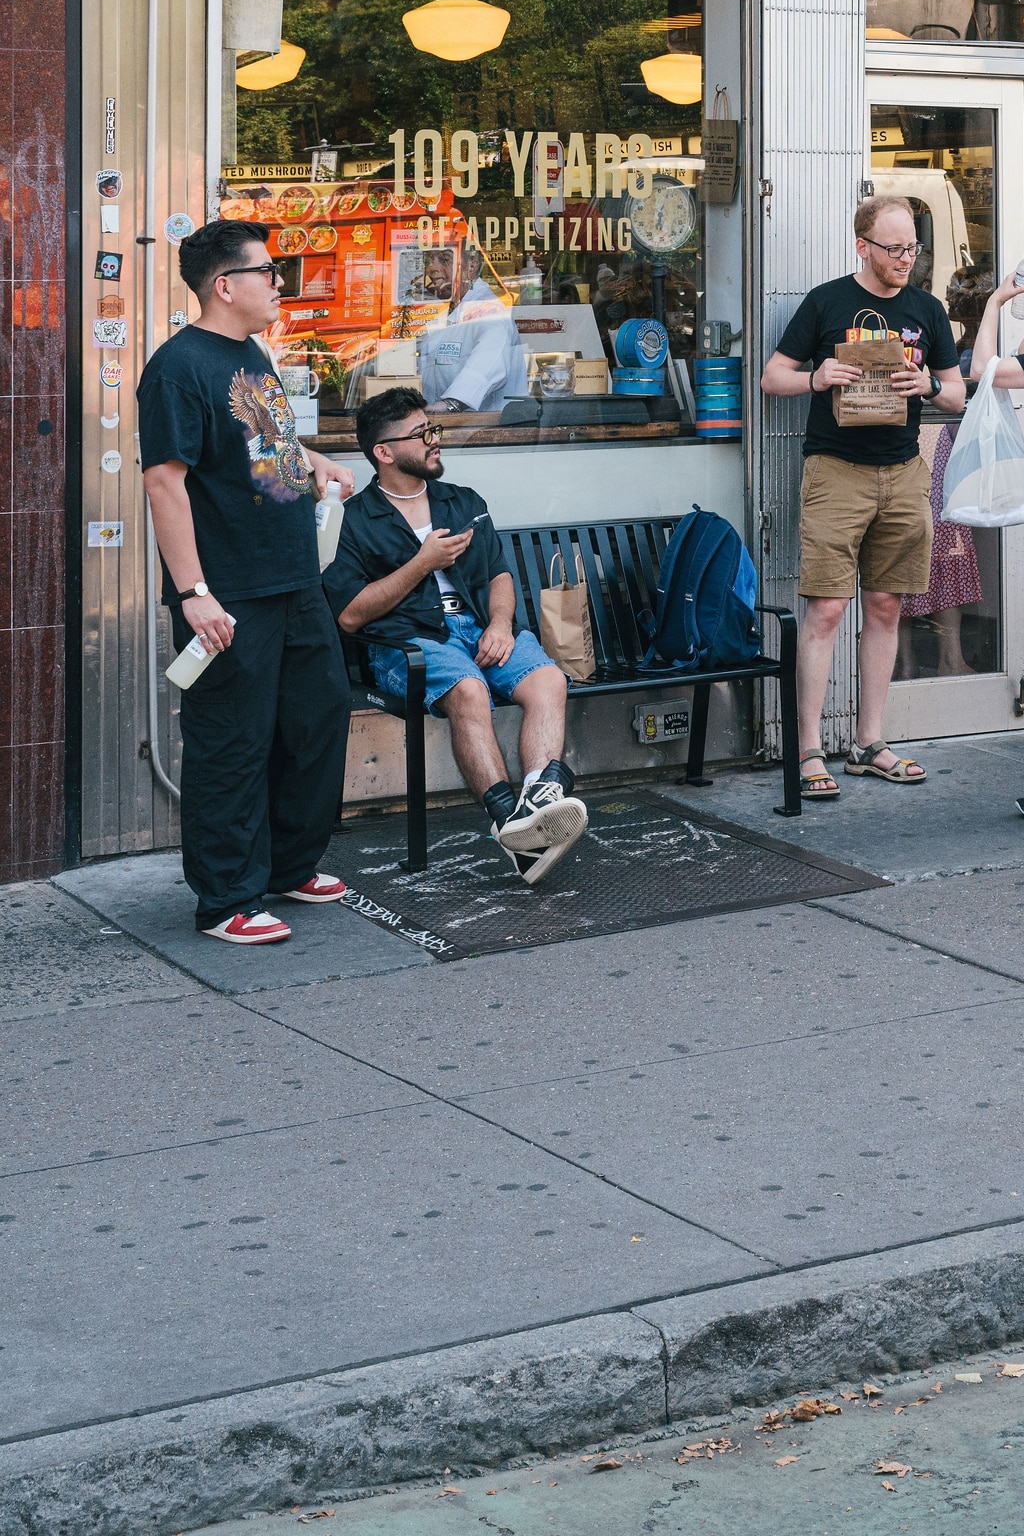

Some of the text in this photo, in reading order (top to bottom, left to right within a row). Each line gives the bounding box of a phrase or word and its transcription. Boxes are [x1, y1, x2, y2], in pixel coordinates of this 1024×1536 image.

[654, 140, 673, 152] ISH
[356, 163, 372, 174] DRIED
[388, 128, 479, 198] 109
[505, 130, 653, 200] YEARS
[416, 215, 632, 252] OF APPETIZING
[636, 319, 667, 344] CAVIAR
[868, 384, 880, 394] LAKE
[664, 713, 688, 724] FRIENDS
[664, 726, 689, 736] NEW YORK
